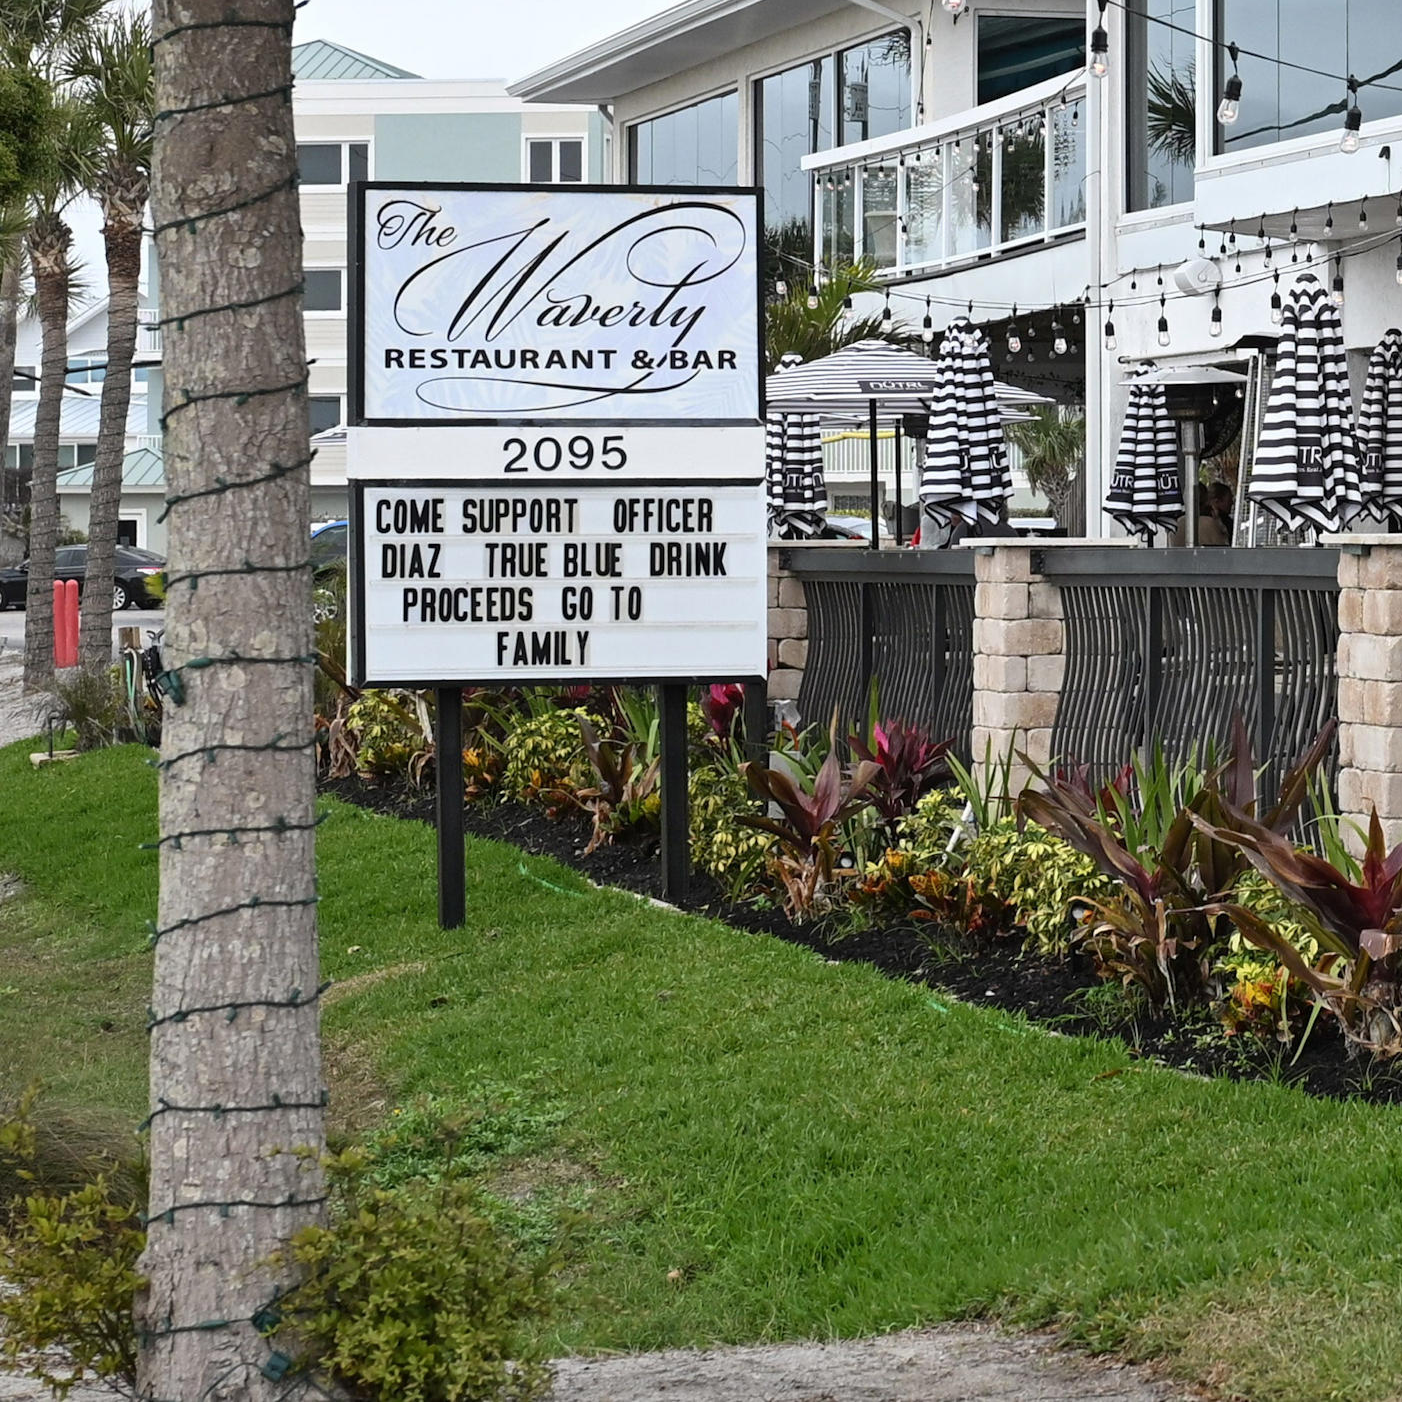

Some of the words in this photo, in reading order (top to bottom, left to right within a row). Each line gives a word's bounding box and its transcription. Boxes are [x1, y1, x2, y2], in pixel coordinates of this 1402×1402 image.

[376, 200, 459, 250] The
[394, 201, 746, 351] Waverly
[384, 347, 618, 370] RESTAURANT
[631, 349, 656, 370] &
[669, 349, 737, 370] BAR
[502, 435, 628, 474] 2095
[376, 498, 444, 535] COME
[462, 498, 579, 534] SUPPORT
[613, 498, 713, 534] OFFICER
[381, 543, 442, 579] DIAZ
[485, 543, 548, 578] TRUE
[563, 543, 623, 578] BLUE
[649, 542, 728, 577] DRINK
[402, 586, 534, 622] PROCEEDS
[561, 586, 593, 621] GO
[611, 586, 642, 621] TO
[496, 630, 590, 667] FAMILY
